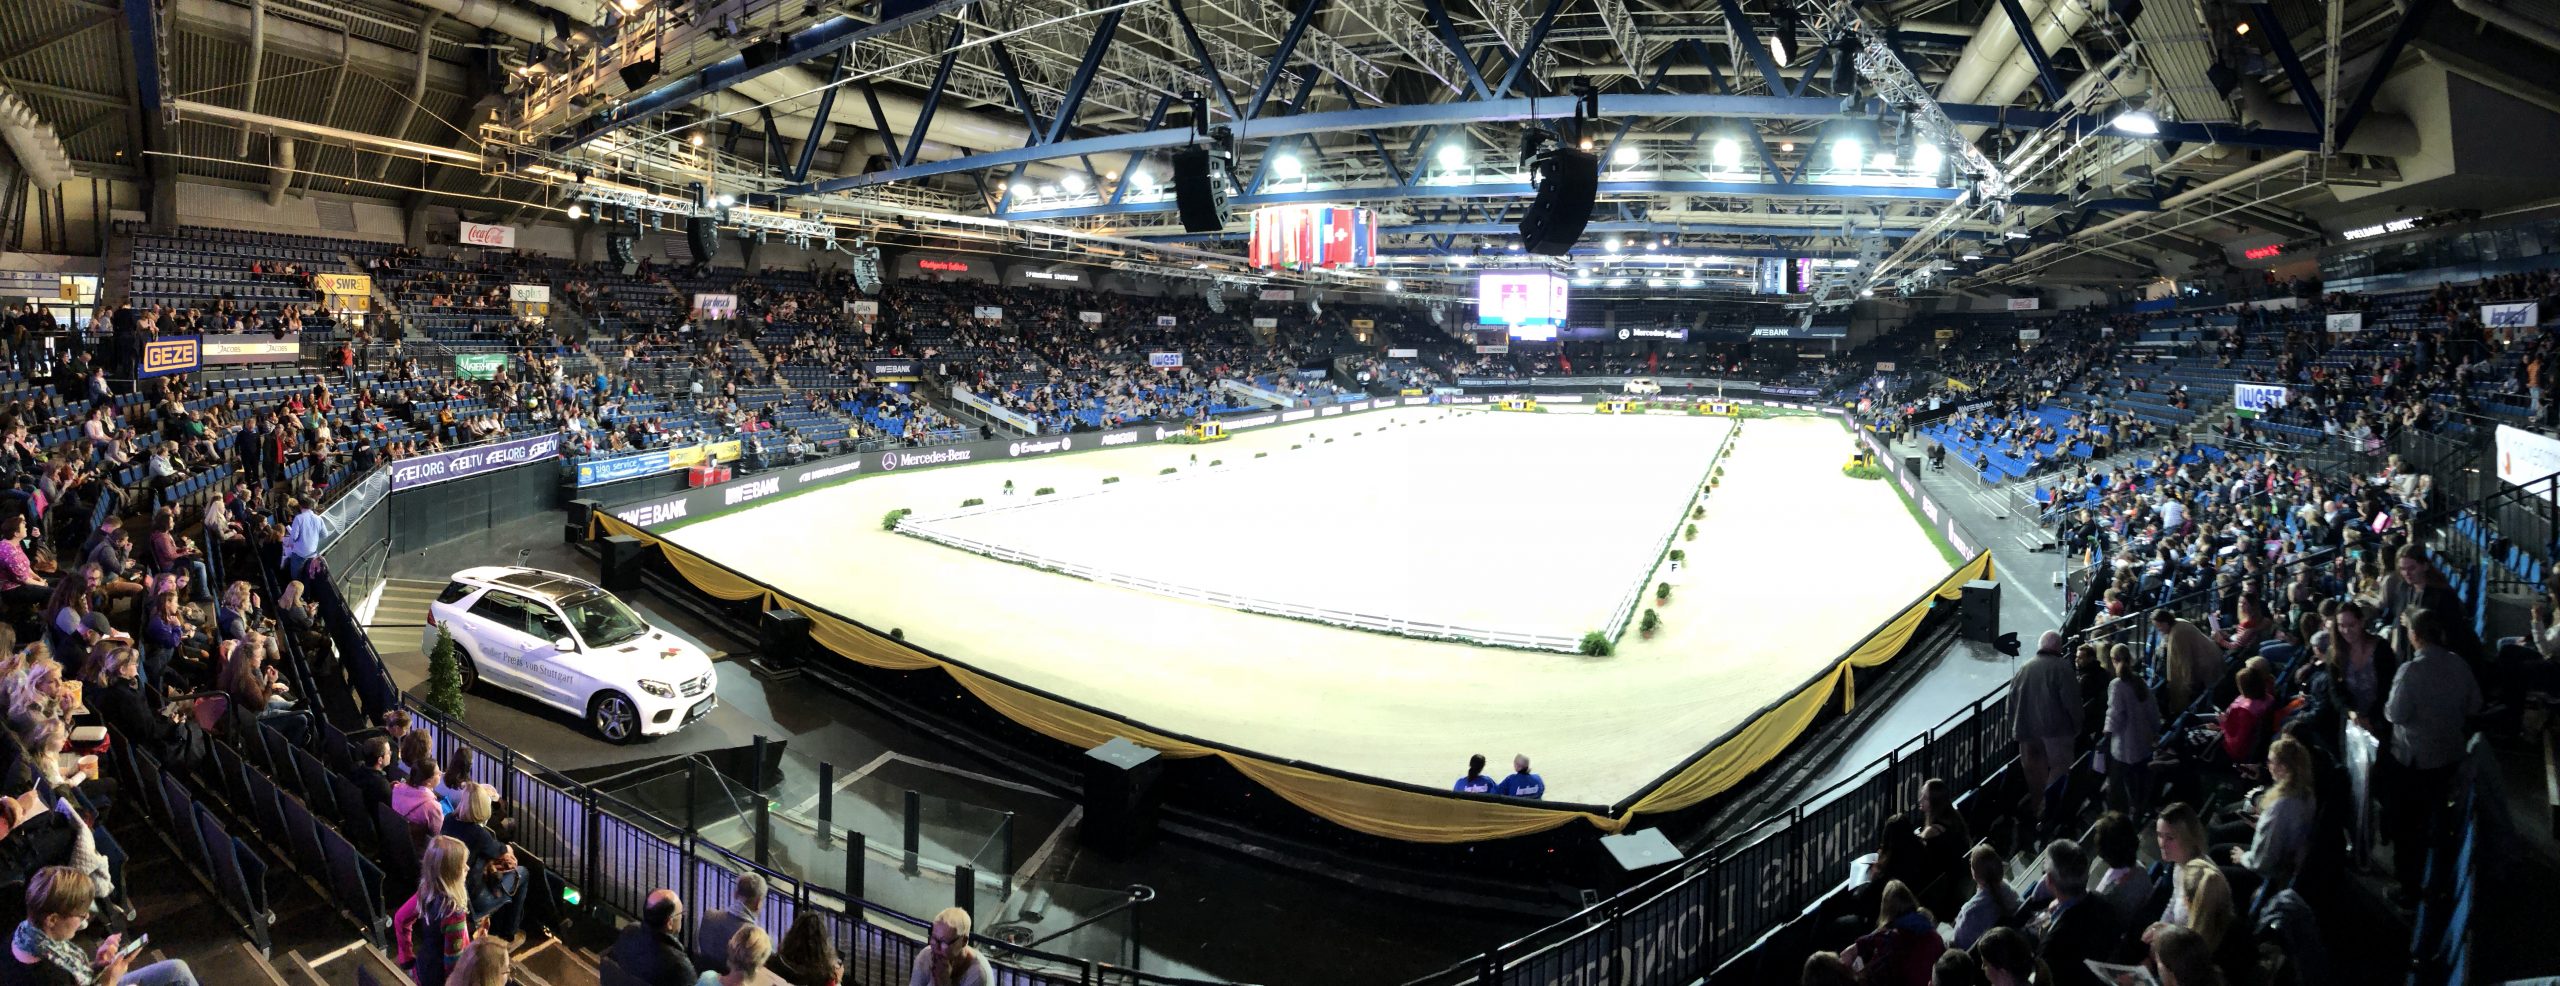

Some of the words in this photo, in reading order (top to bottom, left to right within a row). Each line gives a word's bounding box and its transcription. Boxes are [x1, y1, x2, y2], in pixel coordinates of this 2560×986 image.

[67, 287, 72, 297] 1
[149, 345, 193, 367] GEZE
[900, 449, 971, 467] Mercedes-Benz
[595, 462, 611, 473] sign
[612, 459, 638, 471] service
[1671, 563, 1678, 573] F
